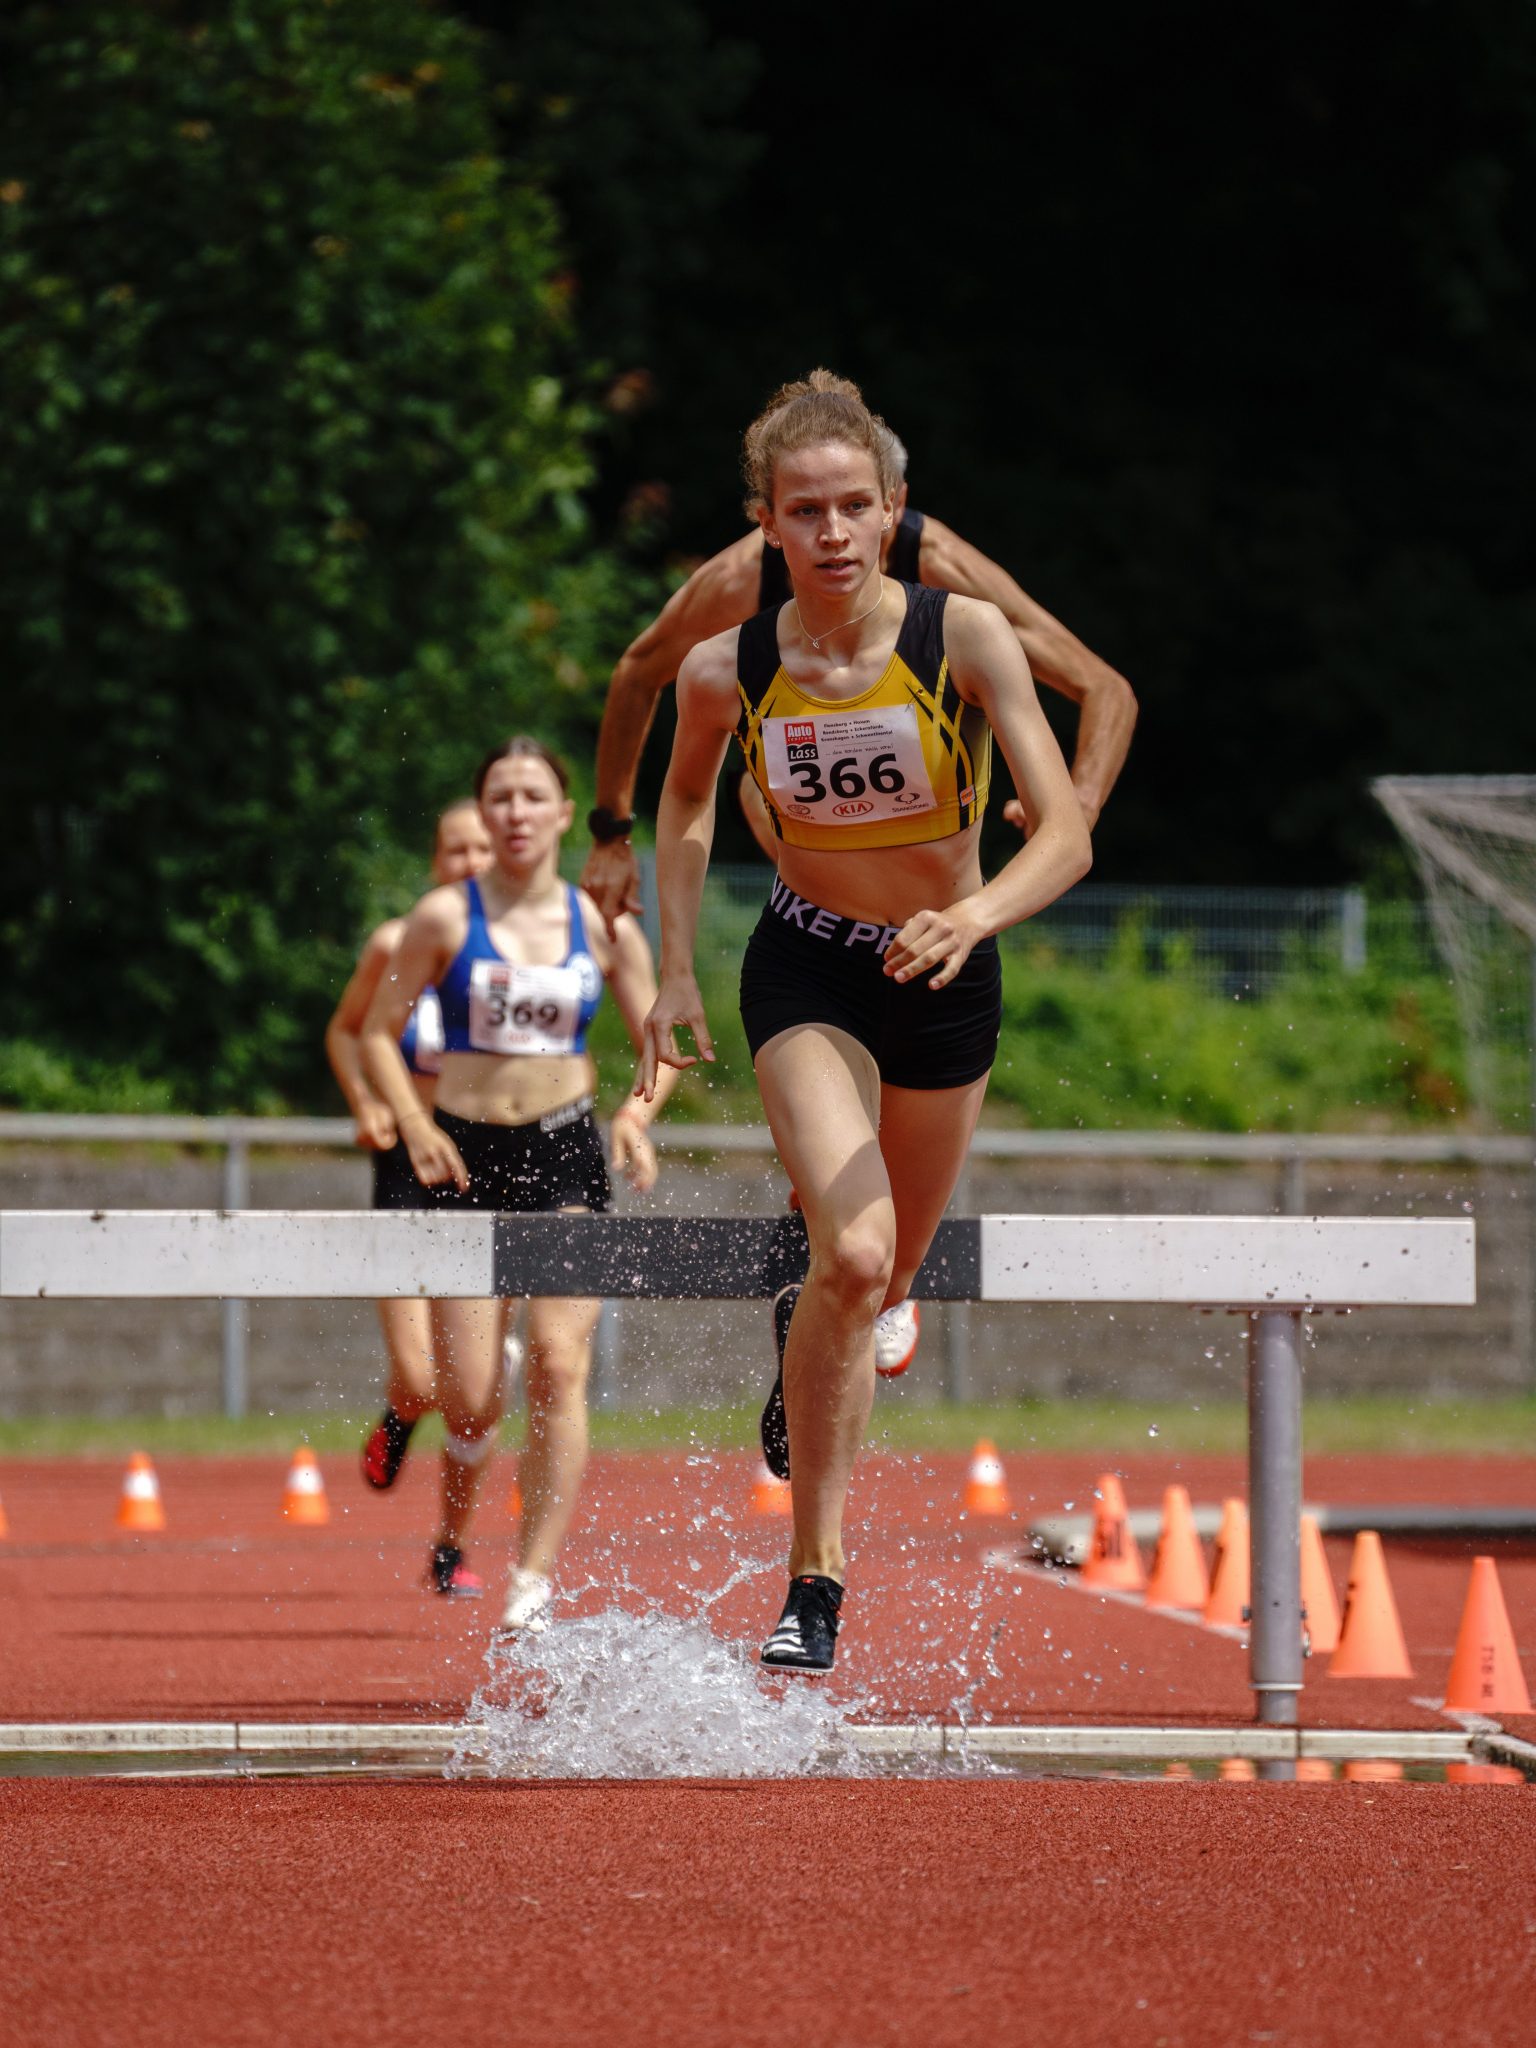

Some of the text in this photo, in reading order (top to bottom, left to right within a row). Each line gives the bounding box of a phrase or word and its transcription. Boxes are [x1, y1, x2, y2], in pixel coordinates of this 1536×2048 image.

[787, 725, 813, 737] Auto
[789, 753, 905, 803] 366
[839, 803, 868, 815] KIA
[770, 872, 842, 940] NIKE
[487, 994, 559, 1030] 369
